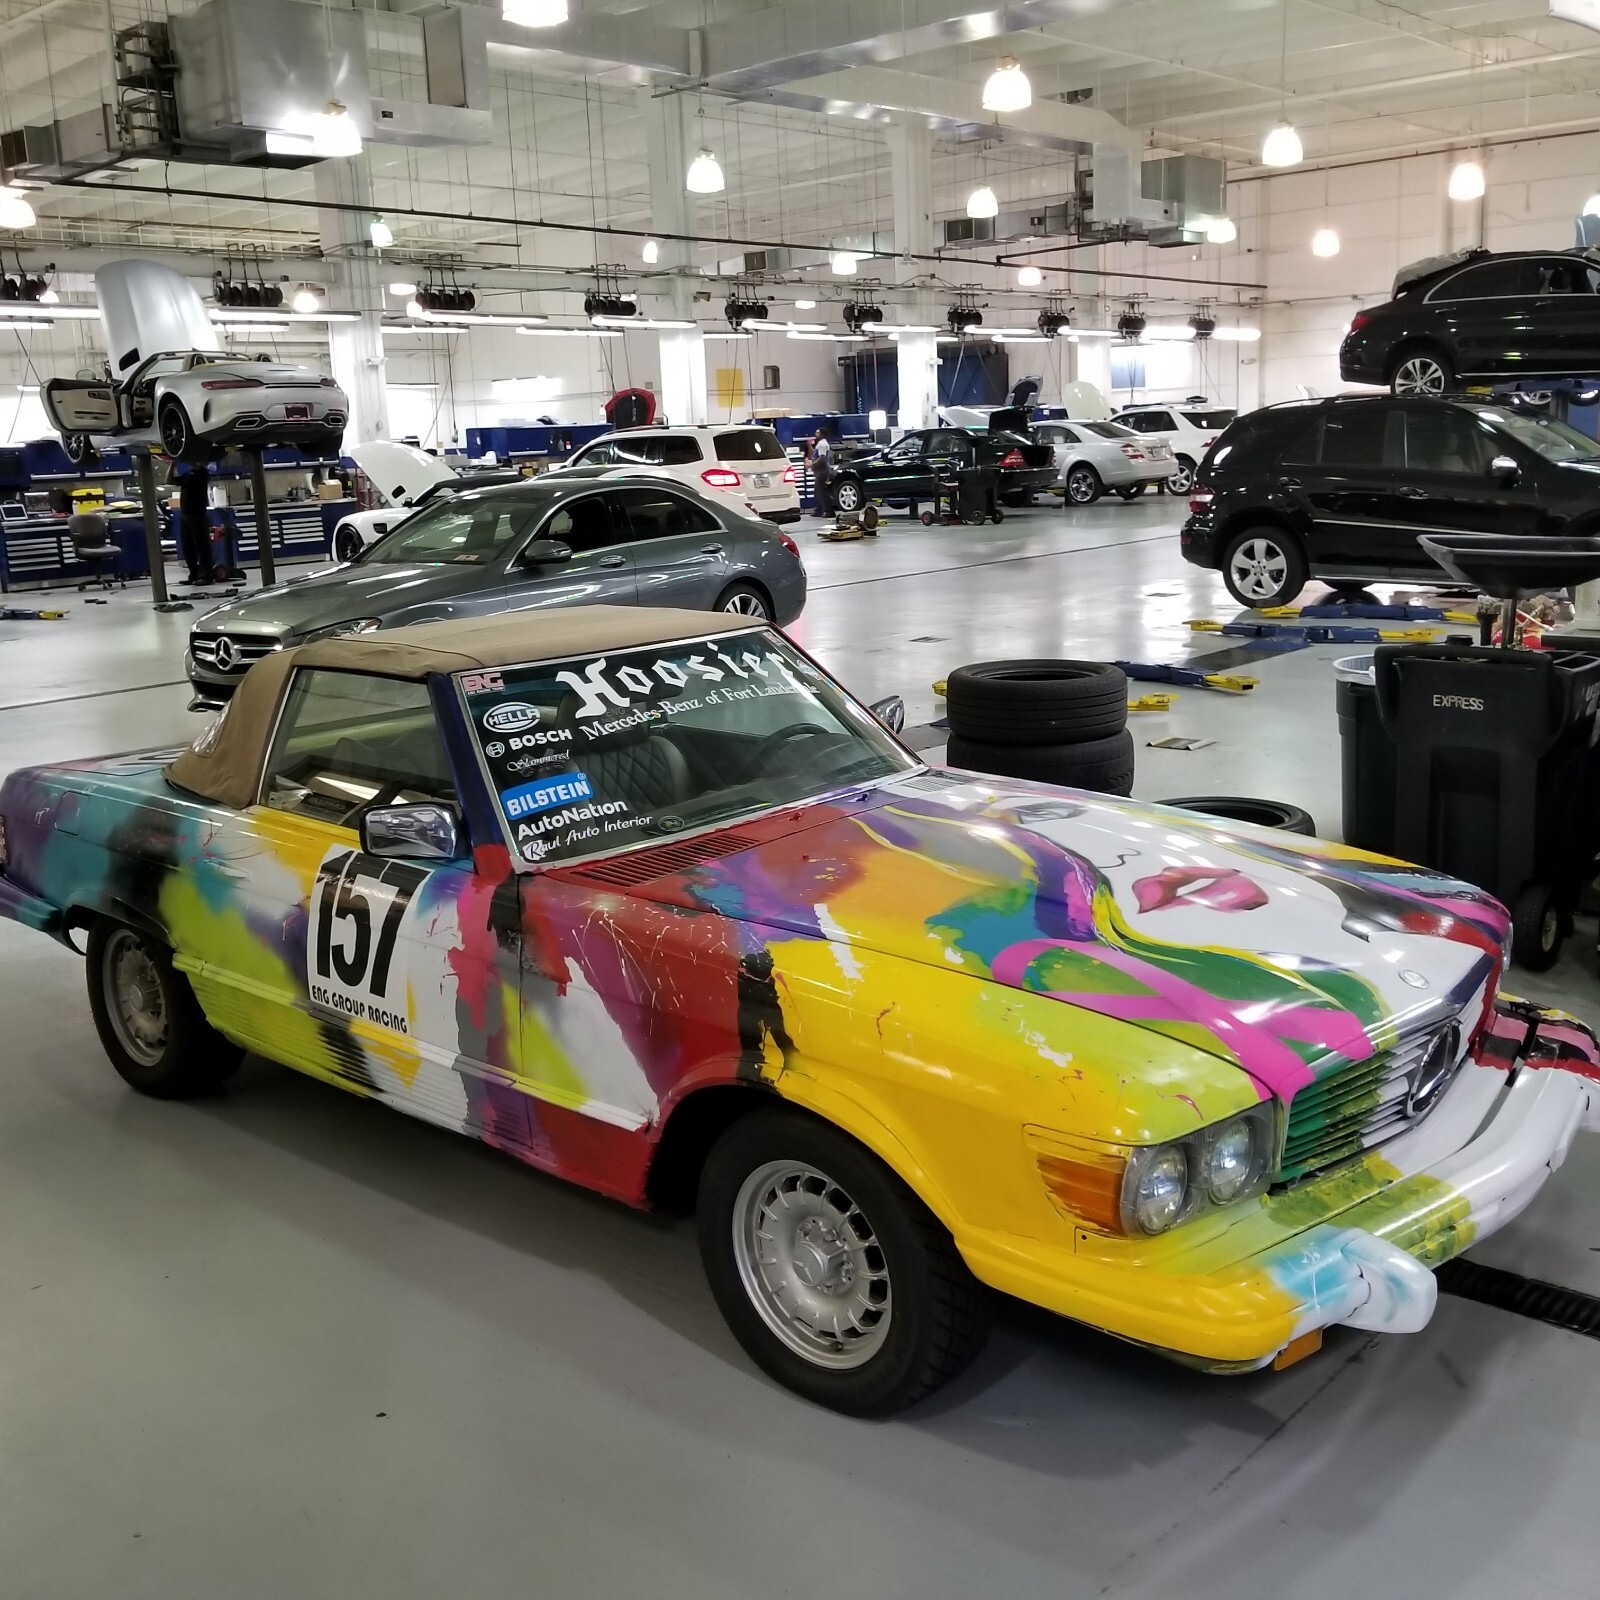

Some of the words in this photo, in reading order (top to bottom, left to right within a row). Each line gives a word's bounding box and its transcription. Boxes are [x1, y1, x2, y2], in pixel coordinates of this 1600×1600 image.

[555, 641, 794, 719] Hoosier
[488, 707, 541, 726] HELLA
[579, 699, 703, 740] Mercedes-Benz
[705, 690, 723, 705] of
[720, 687, 756, 701] Fort
[1433, 694, 1484, 711] EXPRESS
[508, 729, 573, 751] BOSCH
[507, 781, 590, 817] BILSTEIN
[518, 801, 629, 841] AutoNation
[523, 836, 561, 860] Raul
[565, 827, 600, 846] Auto
[604, 815, 653, 833] Interior
[316, 850, 433, 998] 157
[311, 985, 330, 1005] ENG
[331, 993, 365, 1018] GROUP
[367, 1005, 408, 1034] RACING
